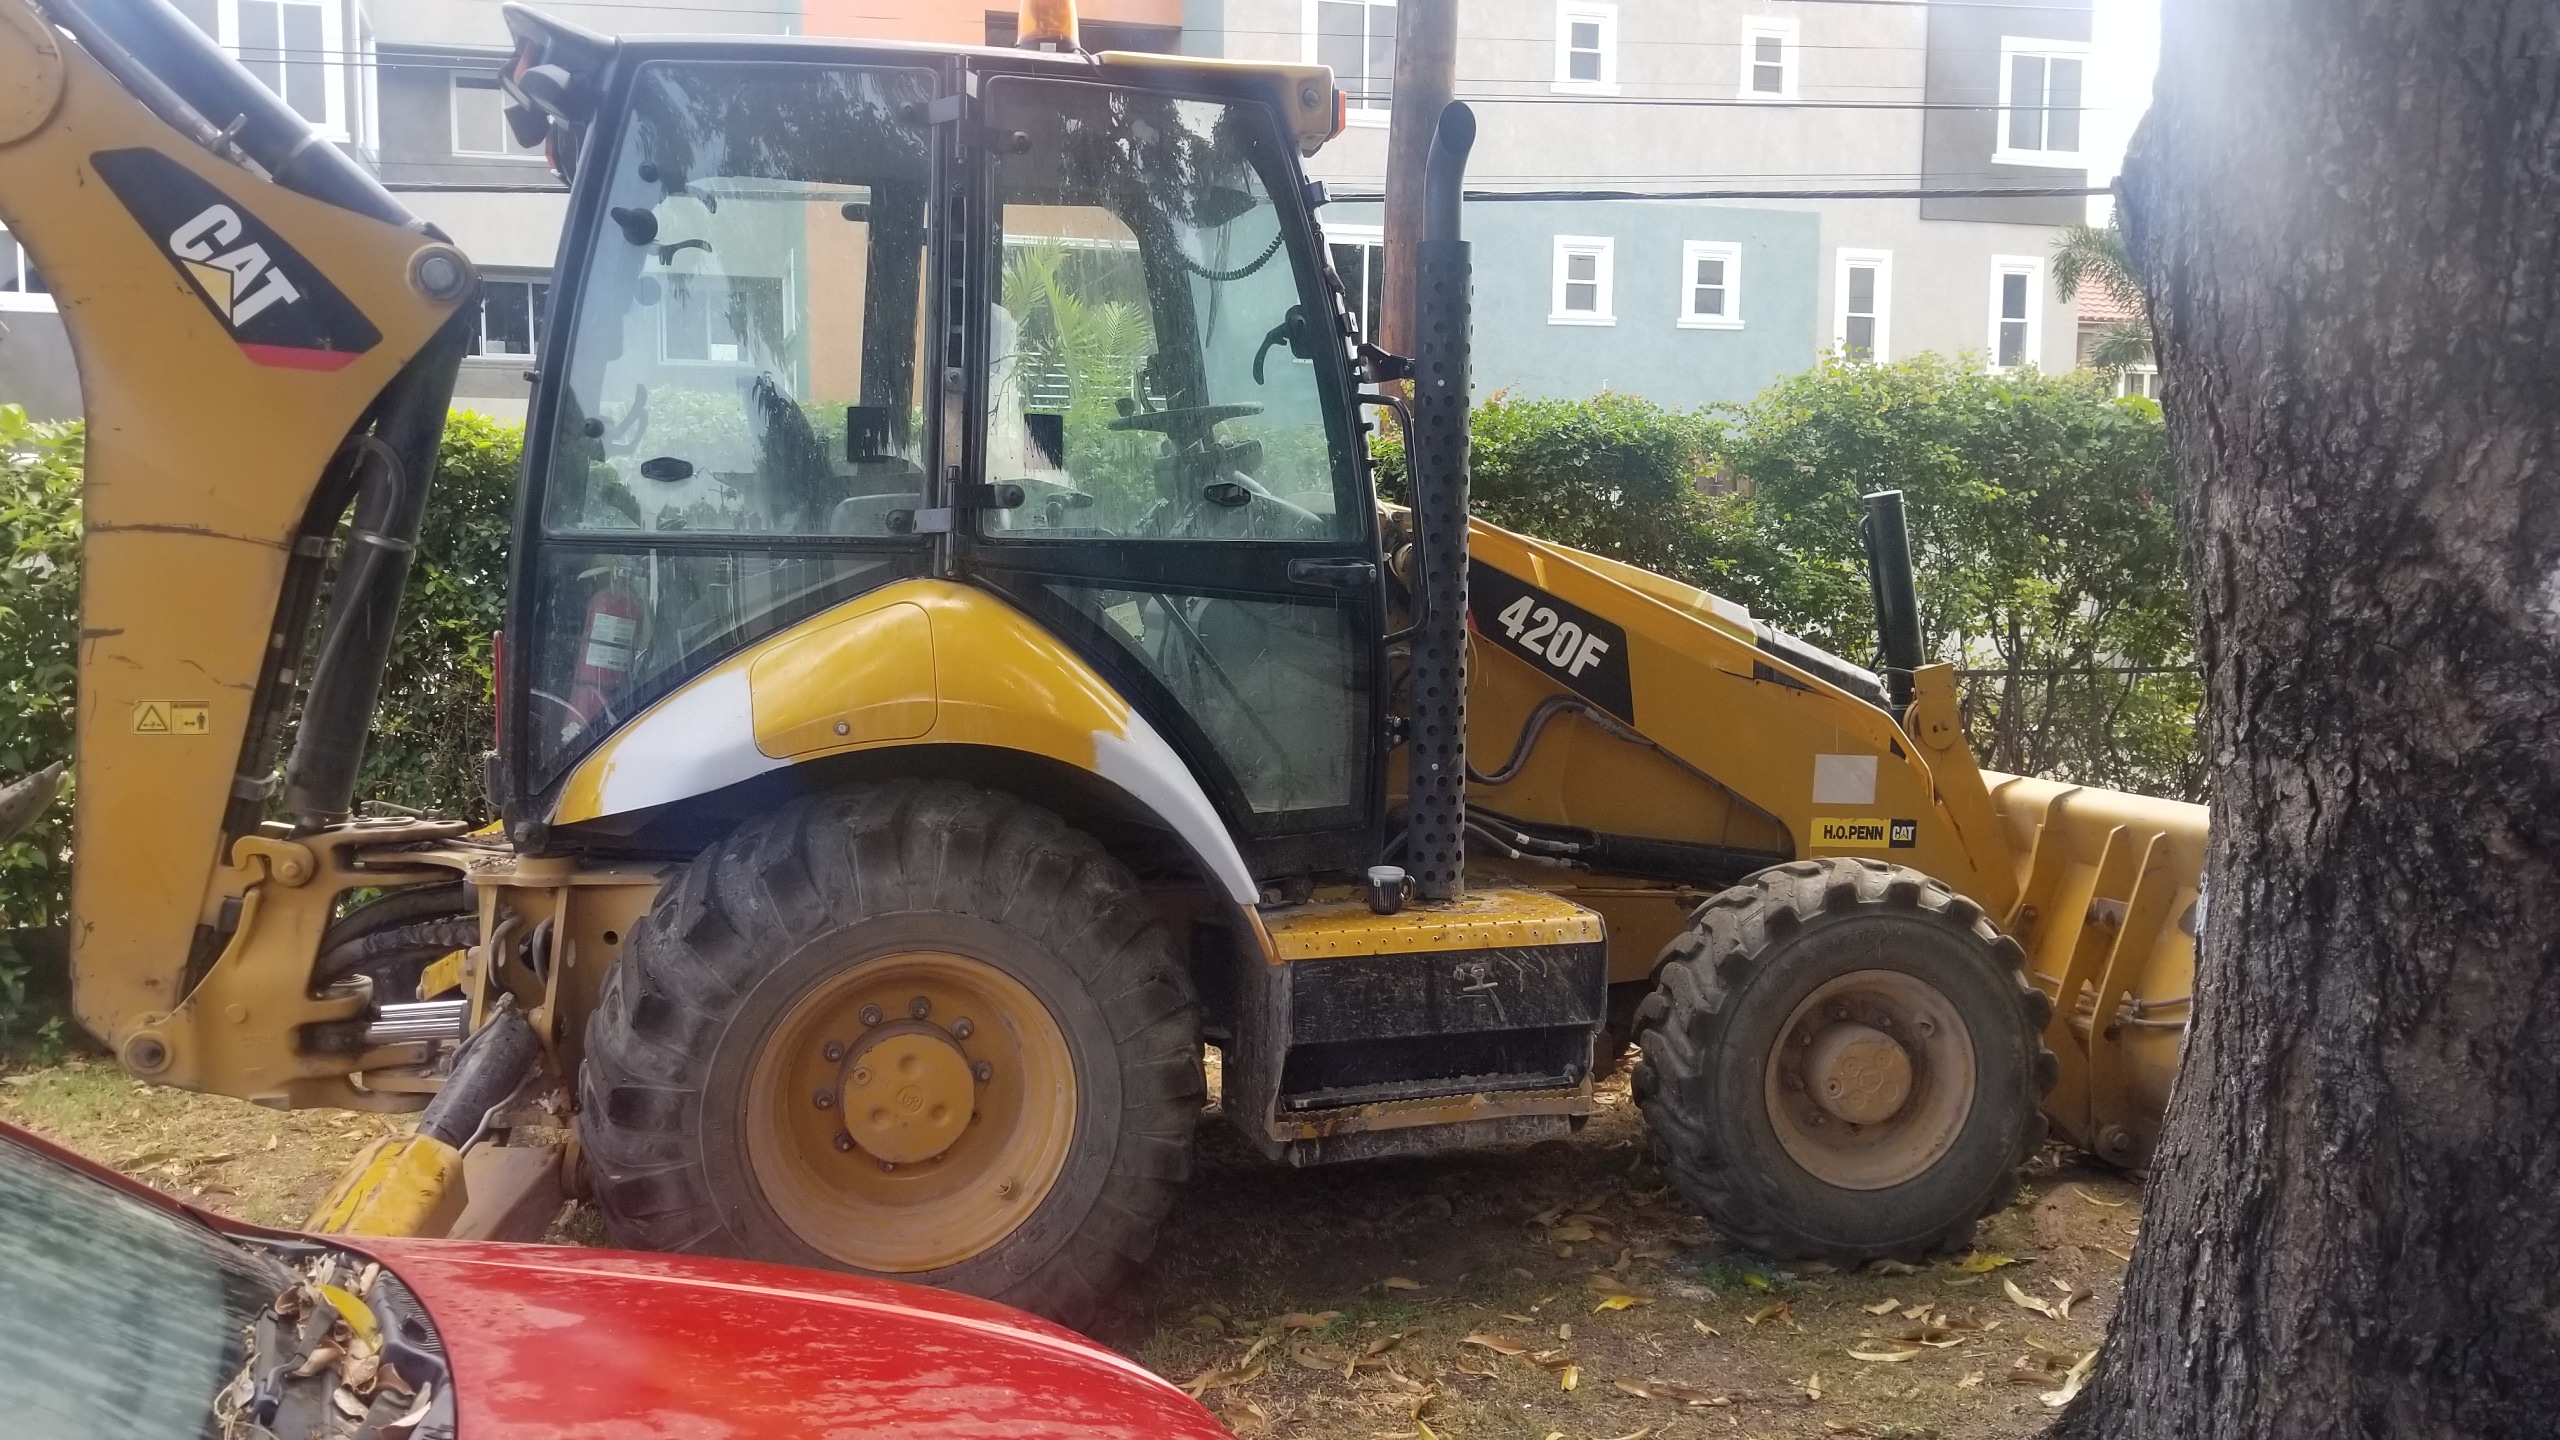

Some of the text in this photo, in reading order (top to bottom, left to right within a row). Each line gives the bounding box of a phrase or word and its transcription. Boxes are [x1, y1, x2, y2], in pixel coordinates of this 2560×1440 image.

[170, 204, 300, 327] CAT
[1498, 595, 1609, 677] 420F
[1892, 826, 1915, 841] CAT
